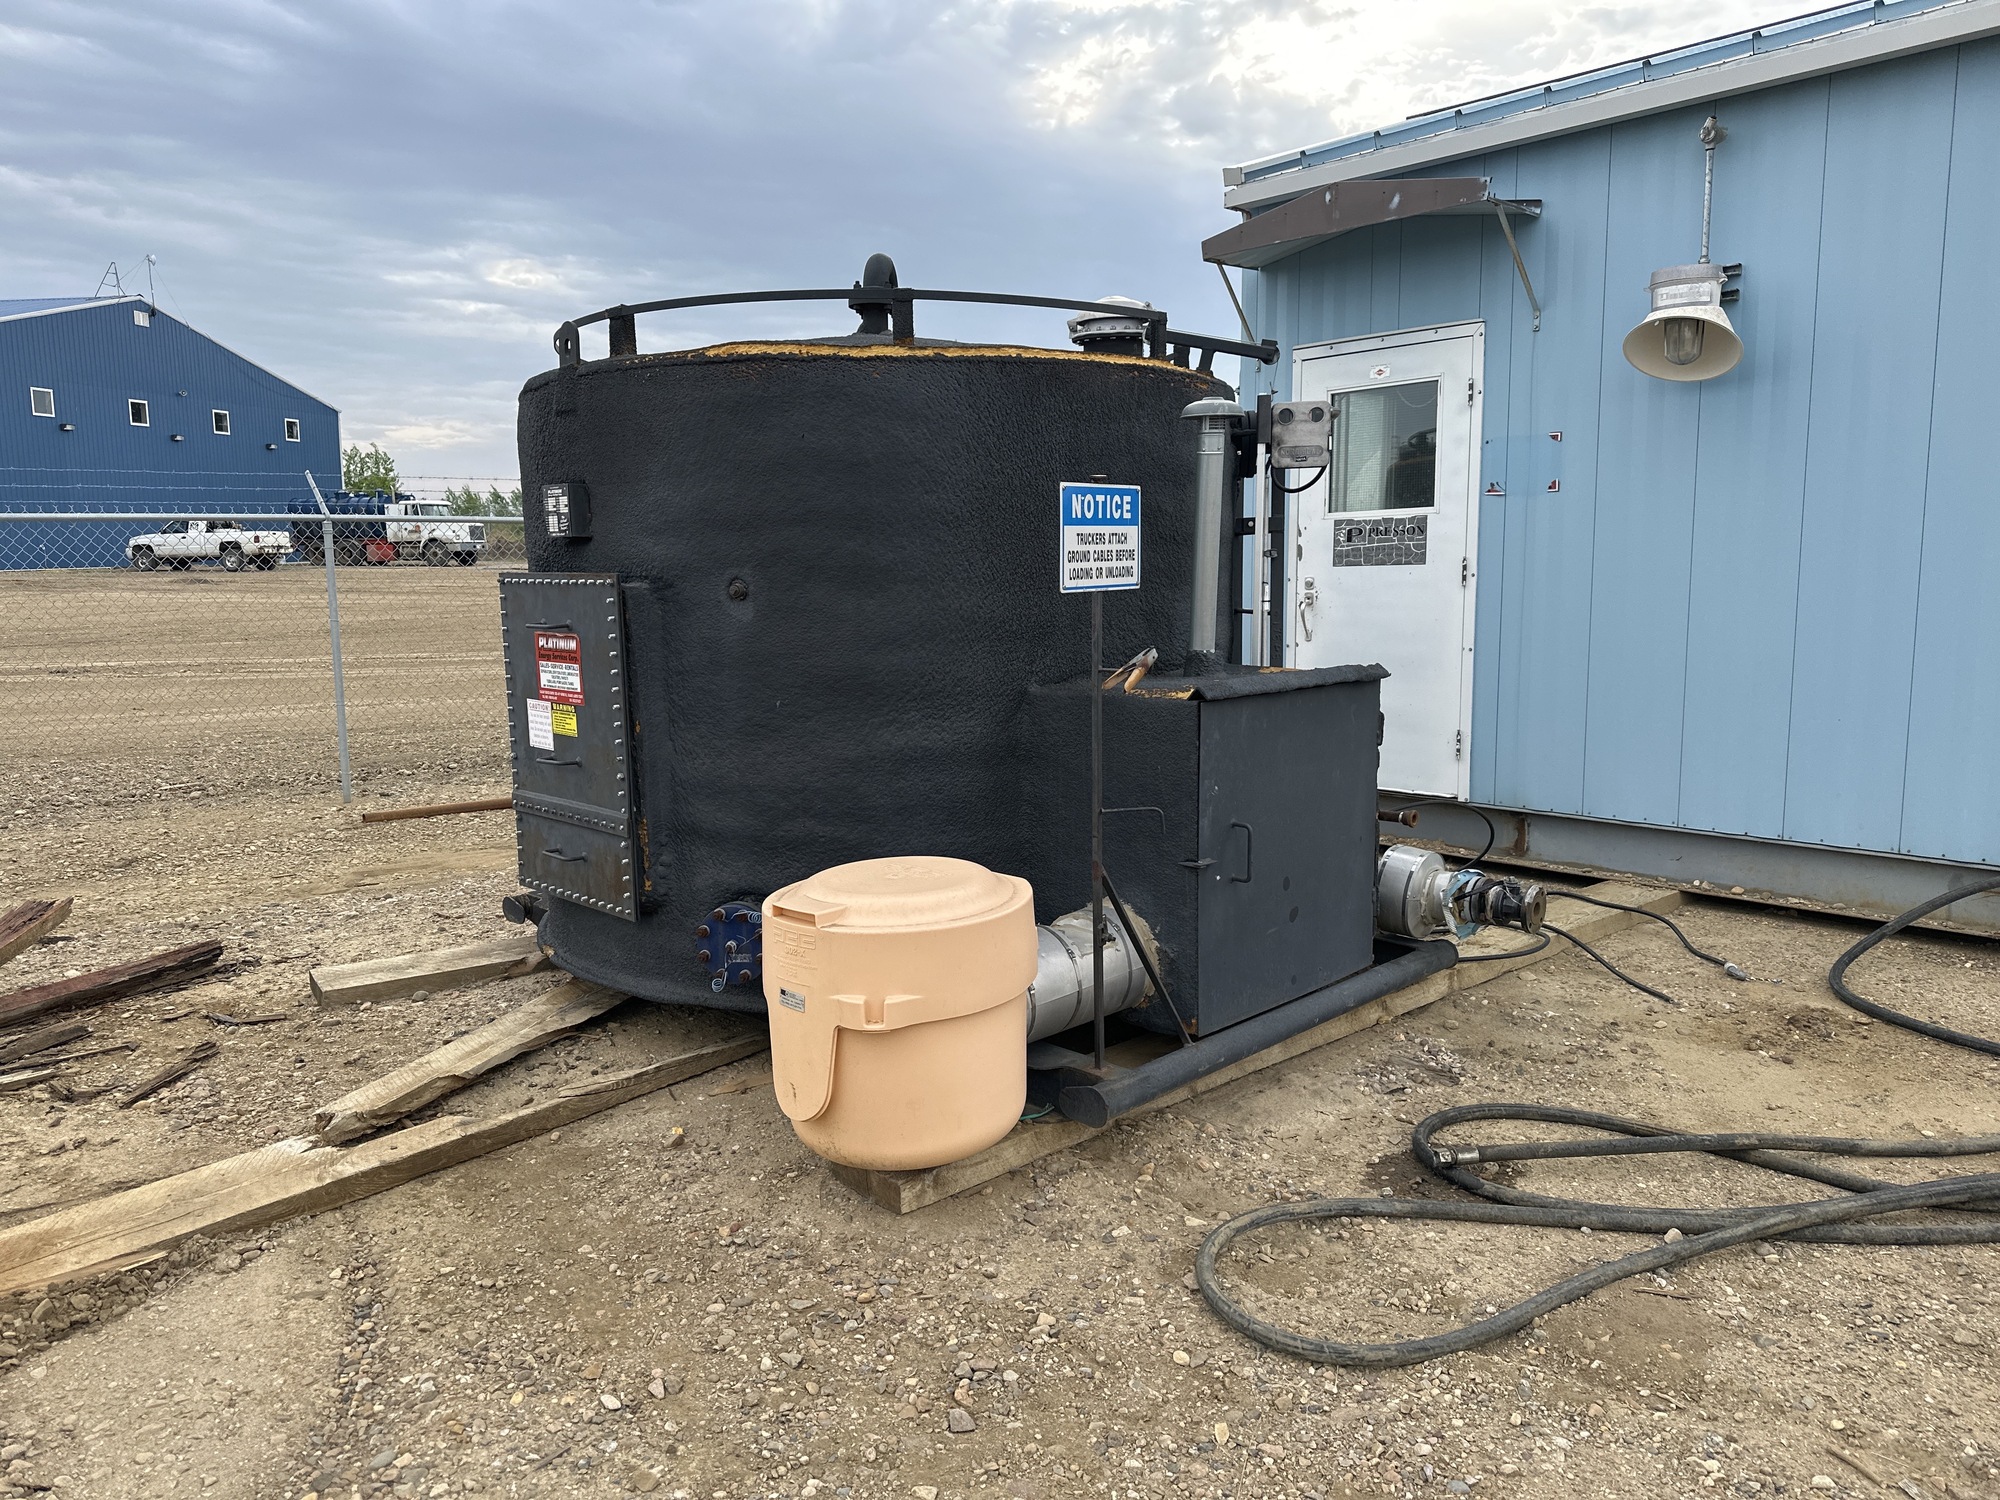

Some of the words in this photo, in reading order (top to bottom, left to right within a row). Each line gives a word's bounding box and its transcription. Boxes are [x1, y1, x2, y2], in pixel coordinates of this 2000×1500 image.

[1071, 493, 1132, 519] NOTICE
[1368, 525, 1424, 537] PRESSON
[1076, 532, 1106, 546] TRUCKERS
[1108, 532, 1128, 545] ATTACH
[1067, 550, 1091, 563] GROUND
[1093, 549, 1114, 562] CABLES
[1115, 549, 1135, 561] BEFORE
[1069, 567, 1093, 580] LOADING
[1096, 567, 1103, 579] OR
[1105, 565, 1134, 578] UNLOADING
[538, 636, 577, 651] PLATINUM
[538, 651, 551, 661] Energy
[552, 652, 567, 661] Services
[552, 702, 575, 713] WARNING
